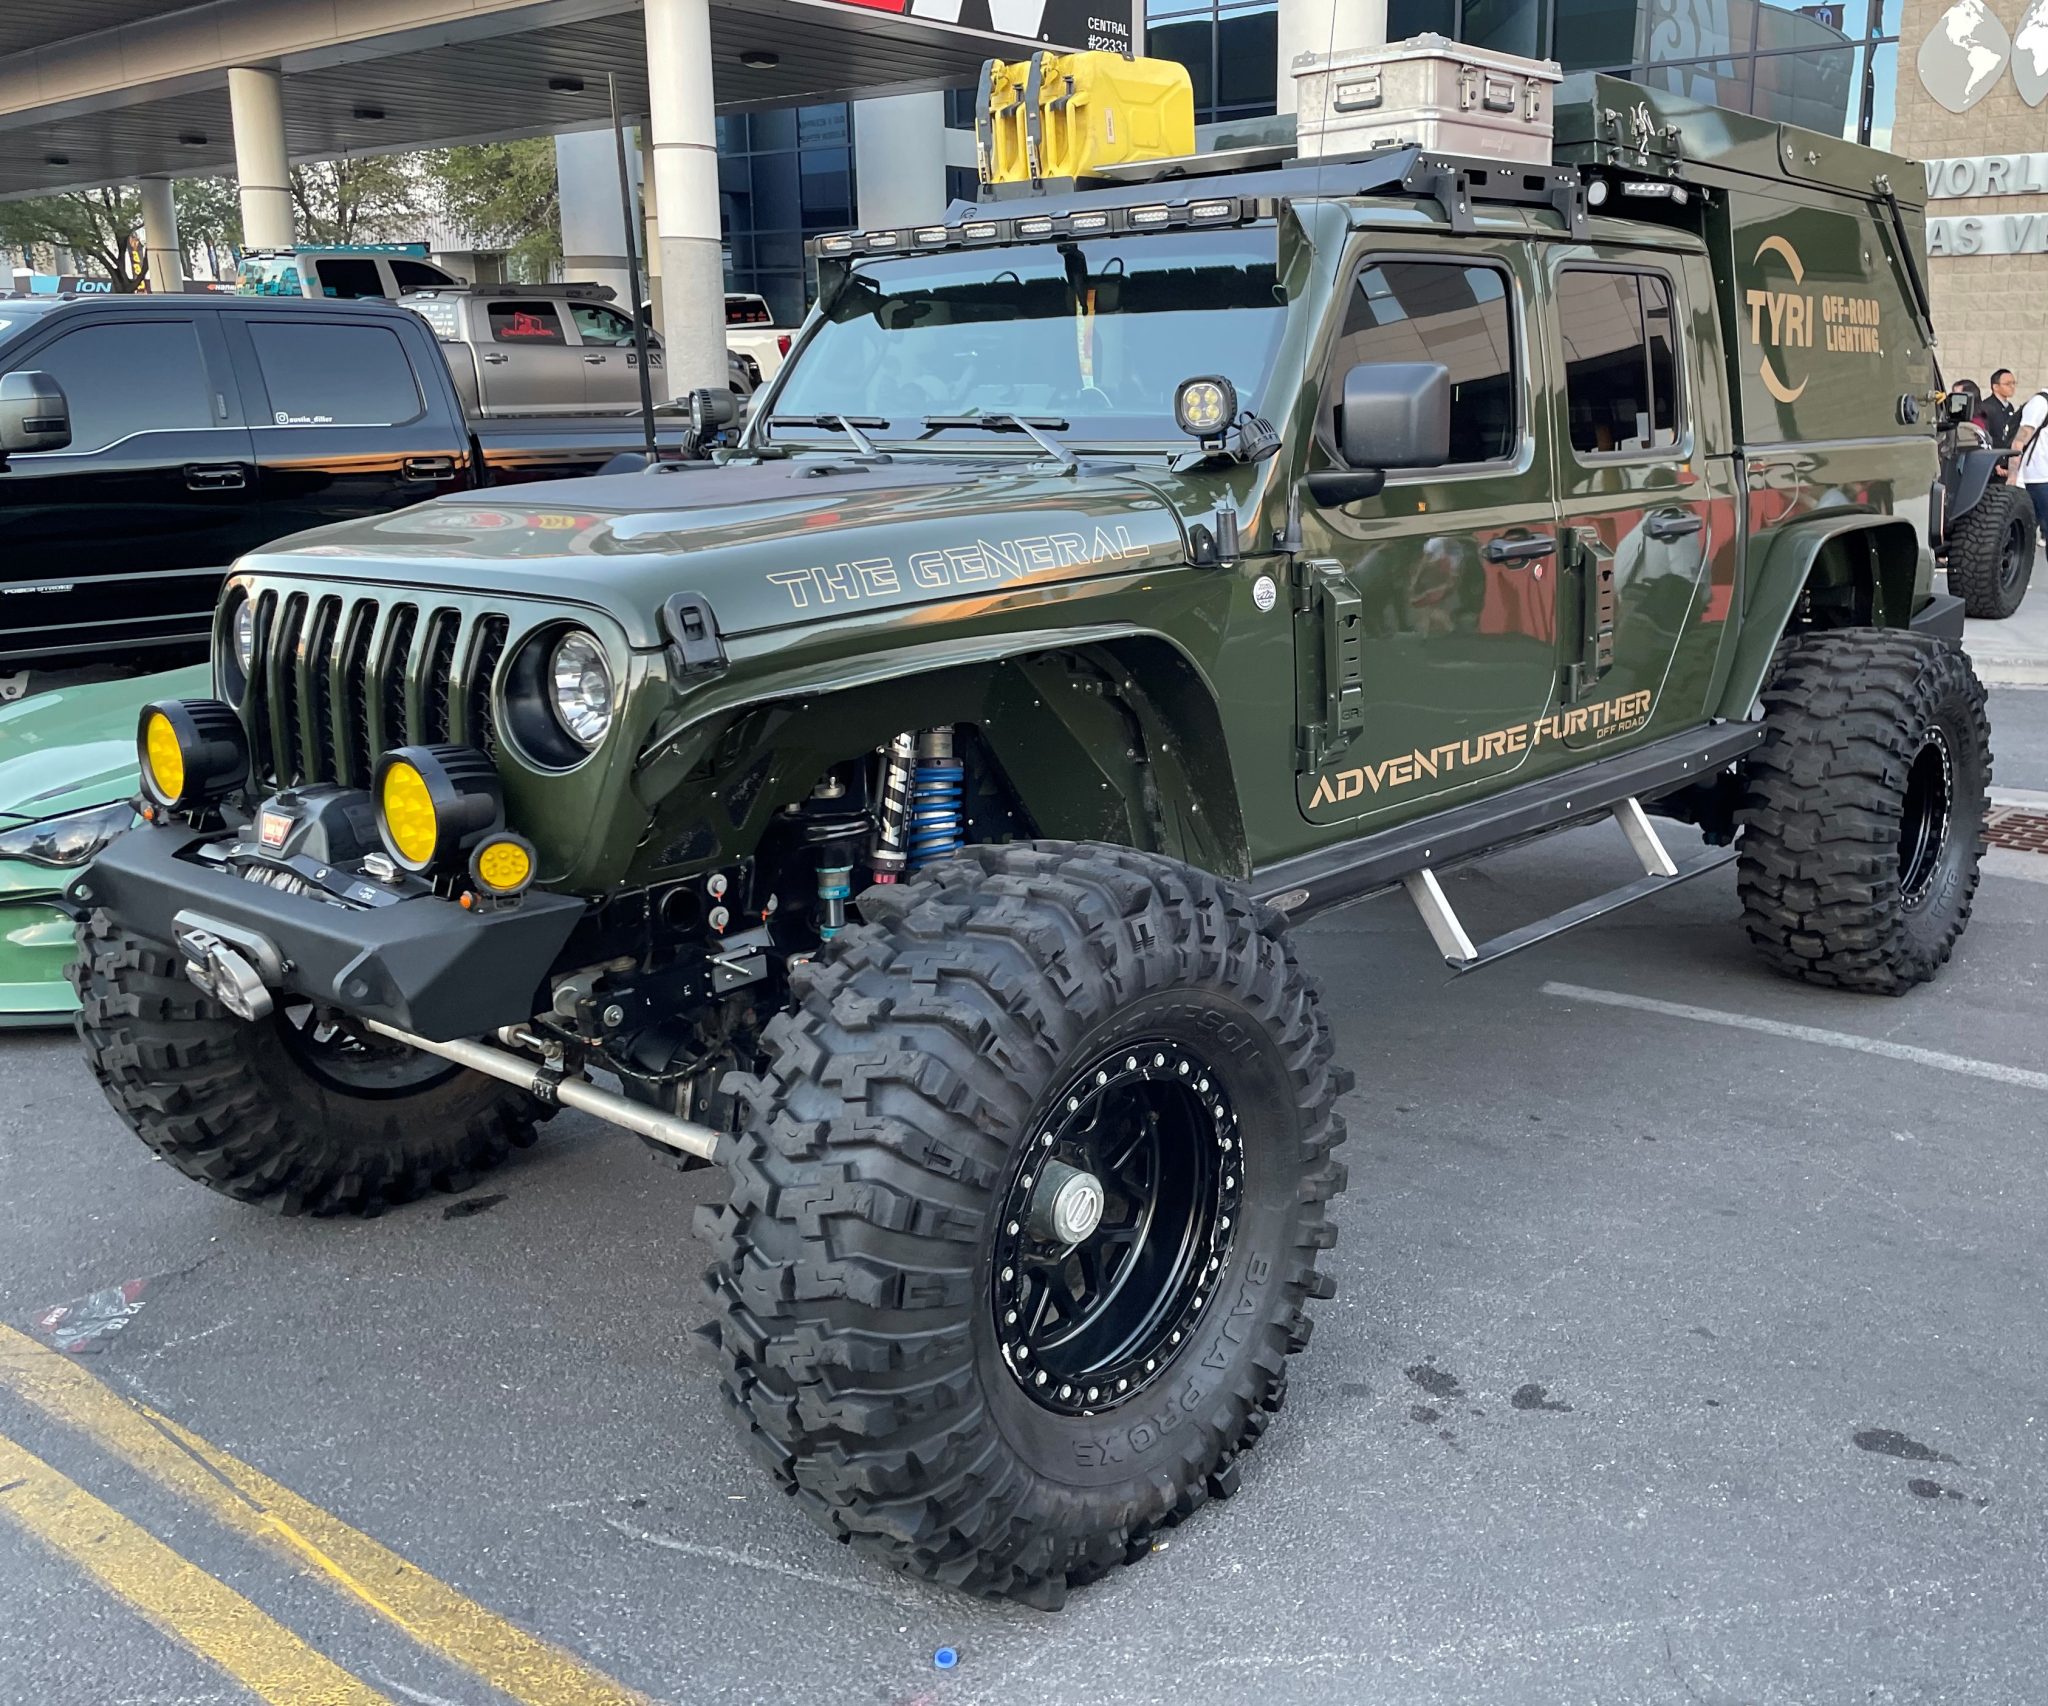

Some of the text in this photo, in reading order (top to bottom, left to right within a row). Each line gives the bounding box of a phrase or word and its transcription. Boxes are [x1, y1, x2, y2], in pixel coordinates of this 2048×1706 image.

[1088, 16, 1129, 37] CENTRAL
[1088, 34, 1128, 52] #22331
[1925, 155, 2048, 197] ORL
[1928, 217, 1983, 256] AS
[1746, 289, 1814, 347] TYRI
[1822, 294, 1880, 326] OFF-ROAD
[1825, 324, 1880, 353] LIGHTING
[766, 525, 1150, 608] THE GENERAL
[1596, 715, 1645, 740] OFF ROAD
[1308, 689, 1651, 810] ADVENTURE FURTHER
[881, 732, 911, 847] KING
[1201, 1250, 1273, 1371] BAJA
[1127, 1375, 1208, 1454] PRO
